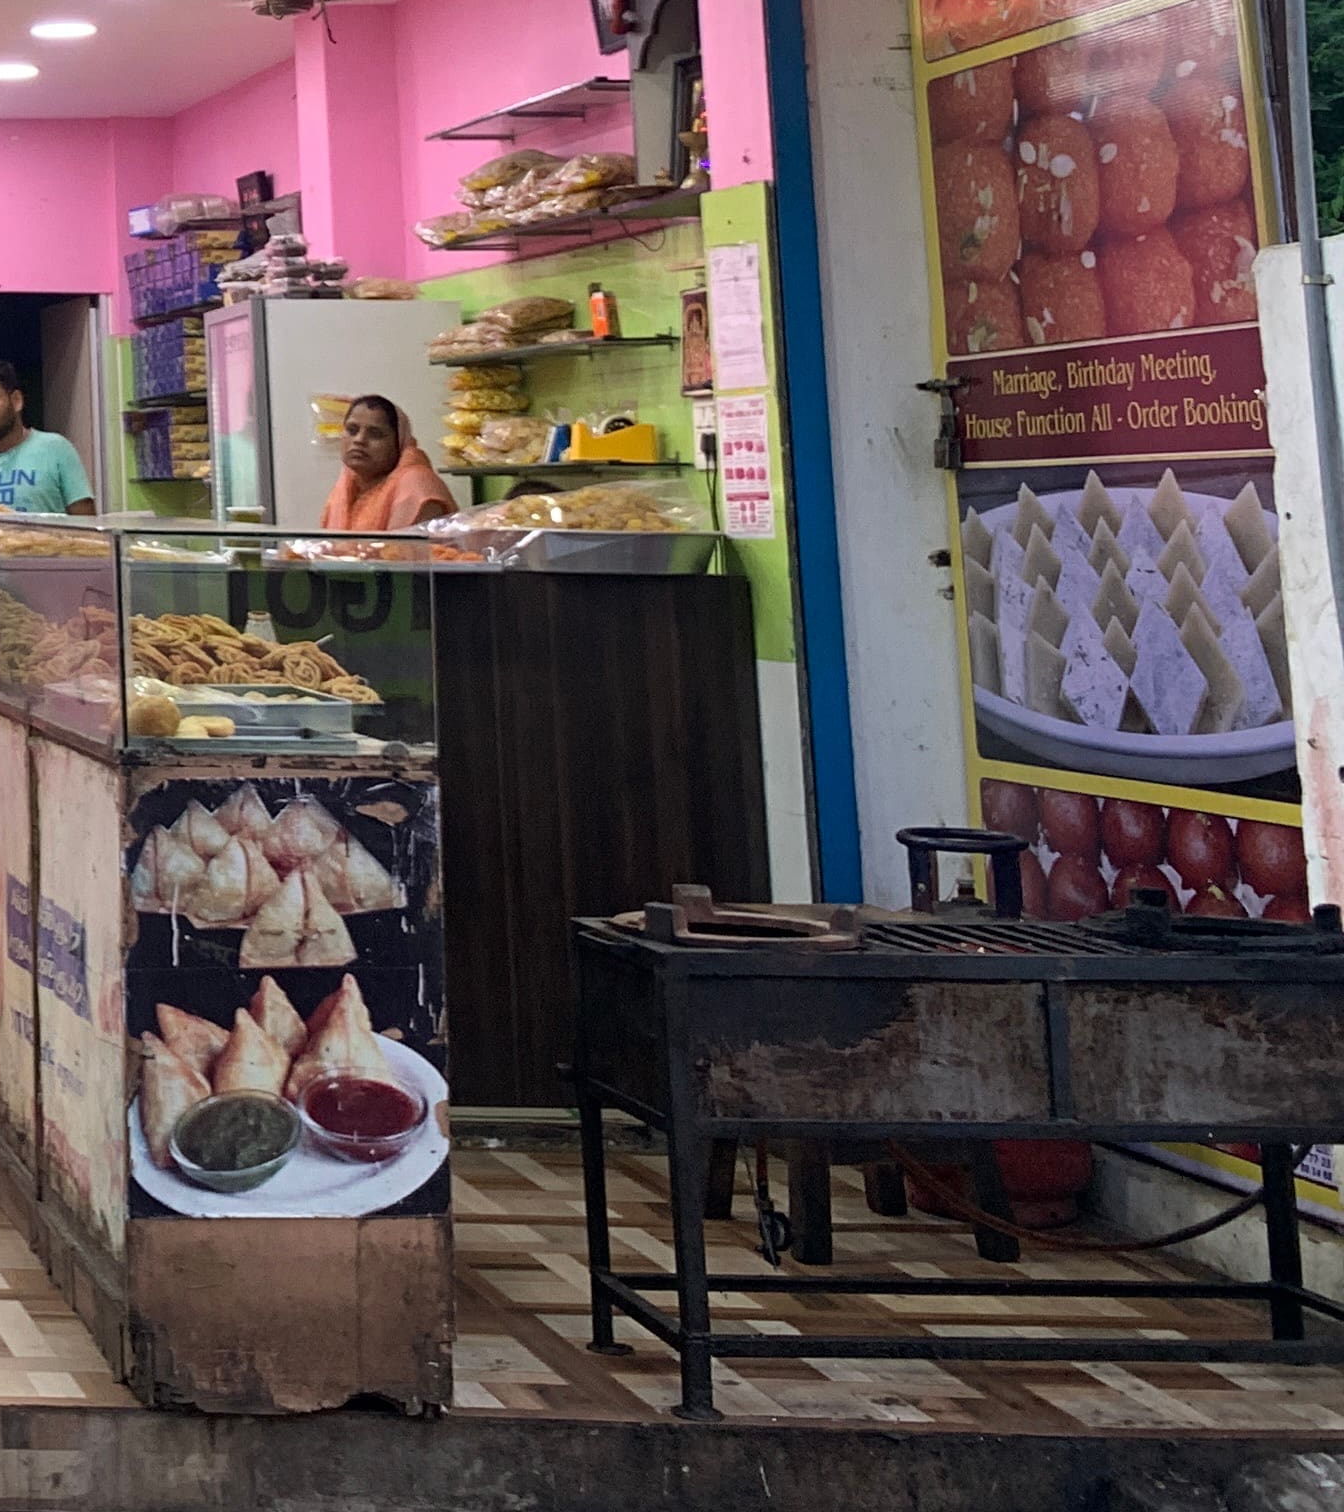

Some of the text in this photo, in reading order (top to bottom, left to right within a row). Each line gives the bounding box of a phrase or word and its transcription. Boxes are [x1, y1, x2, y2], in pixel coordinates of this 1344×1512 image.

[992, 351, 1218, 400] Marriage, Birthday Meeting,
[966, 412, 1012, 440] House
[1016, 408, 1086, 438] Function
[1091, 403, 1113, 432] All
[1127, 399, 1180, 430] Order
[1184, 395, 1265, 430] Booking
